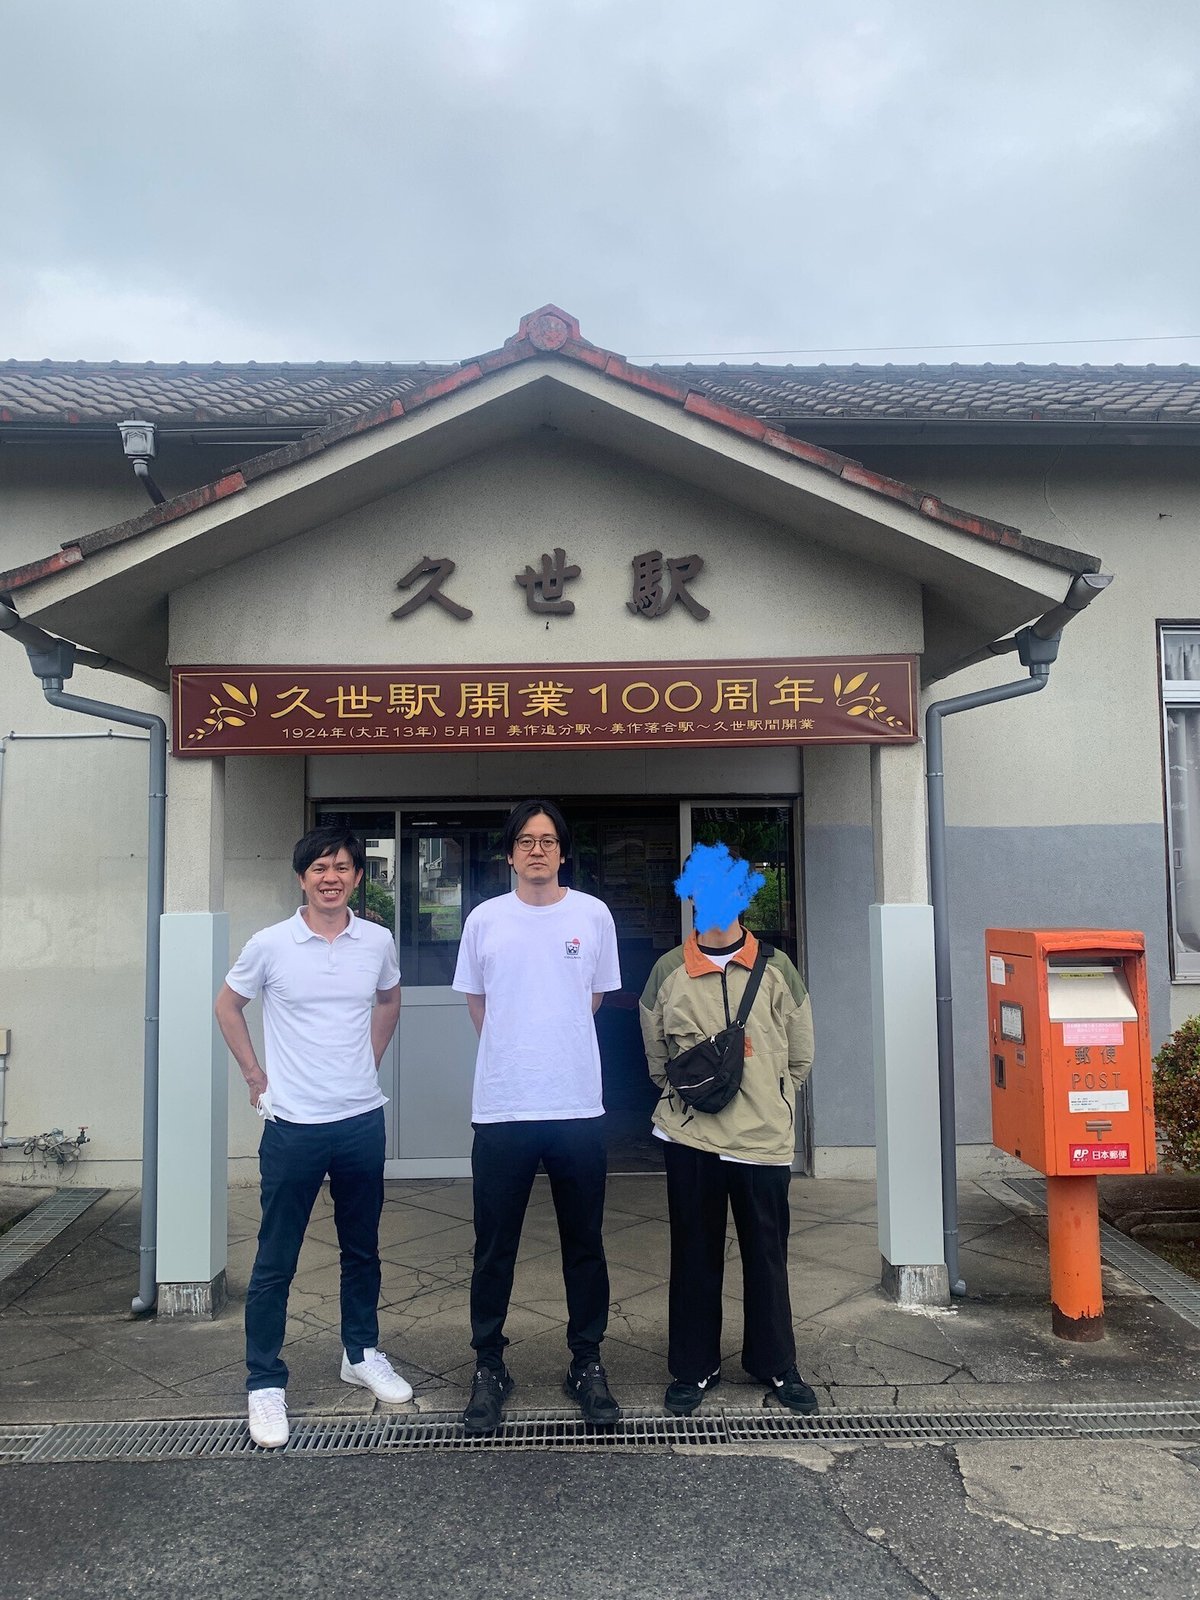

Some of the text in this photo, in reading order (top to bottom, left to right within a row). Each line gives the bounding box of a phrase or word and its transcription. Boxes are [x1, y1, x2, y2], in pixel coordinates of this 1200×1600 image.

[391, 548, 711, 621] 久世駅
[270, 676, 824, 719] 久世駅開業100周年
[1075, 1046, 1117, 1065] 郵便
[1072, 1073, 1121, 1089] POST
[1092, 1150, 1128, 1160] 日本郵便
